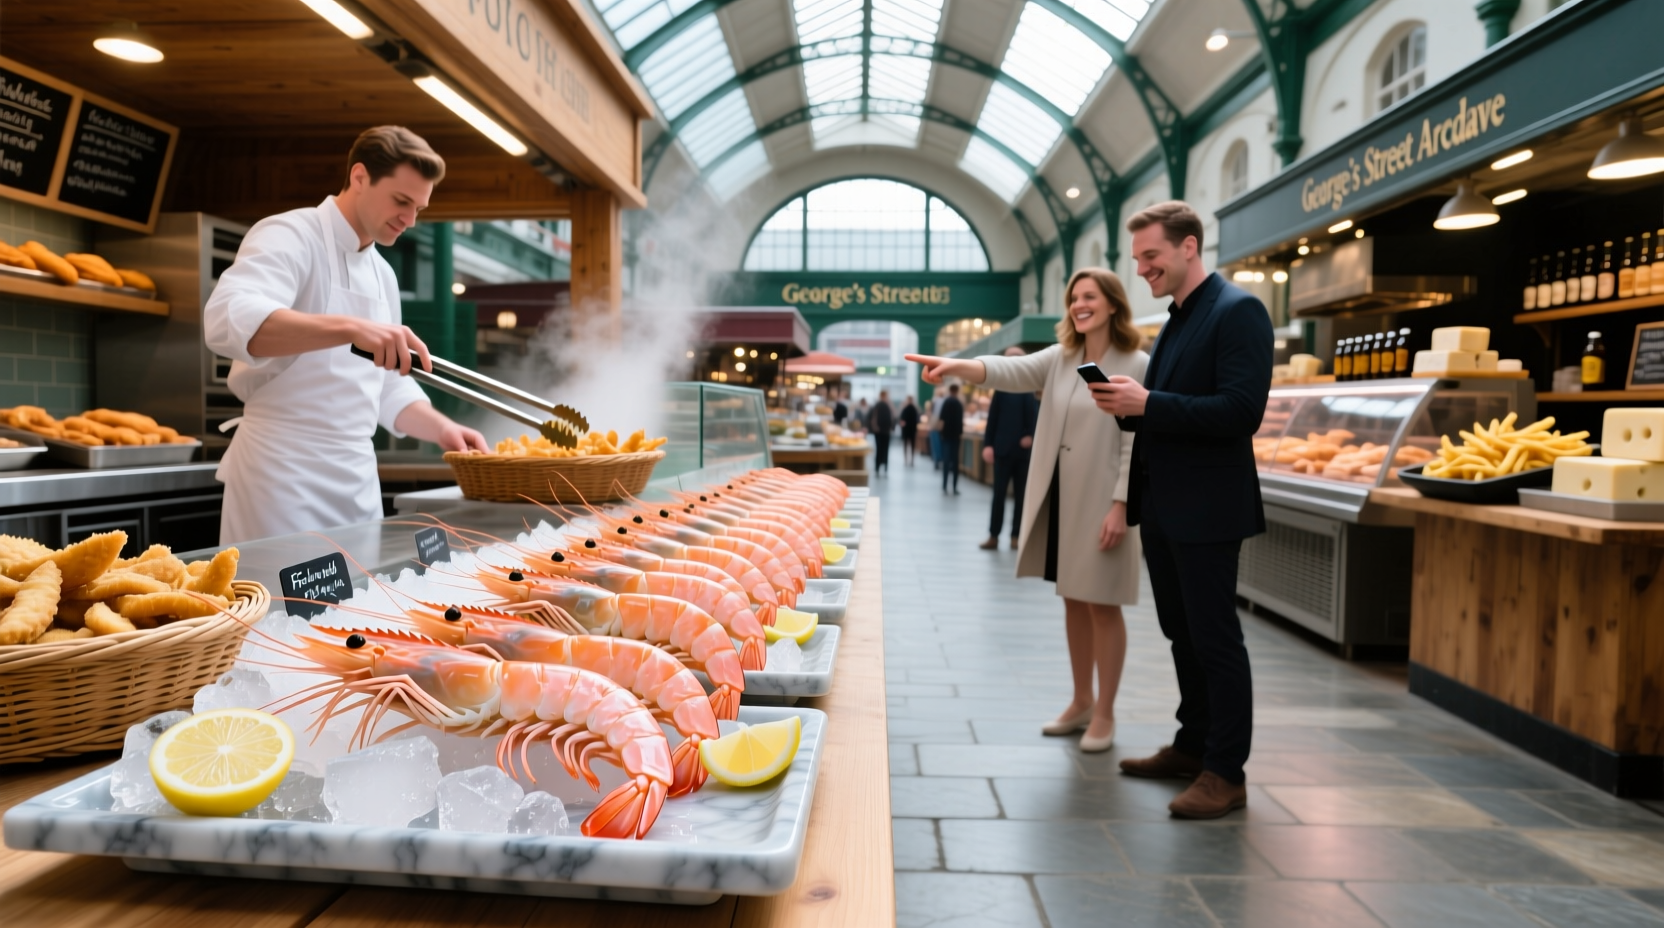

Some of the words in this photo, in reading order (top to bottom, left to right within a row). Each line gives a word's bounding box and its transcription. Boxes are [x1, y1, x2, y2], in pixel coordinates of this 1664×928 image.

[1302, 158, 1360, 212] George's
[1363, 132, 1414, 186] Street
[781, 282, 866, 309] George's
